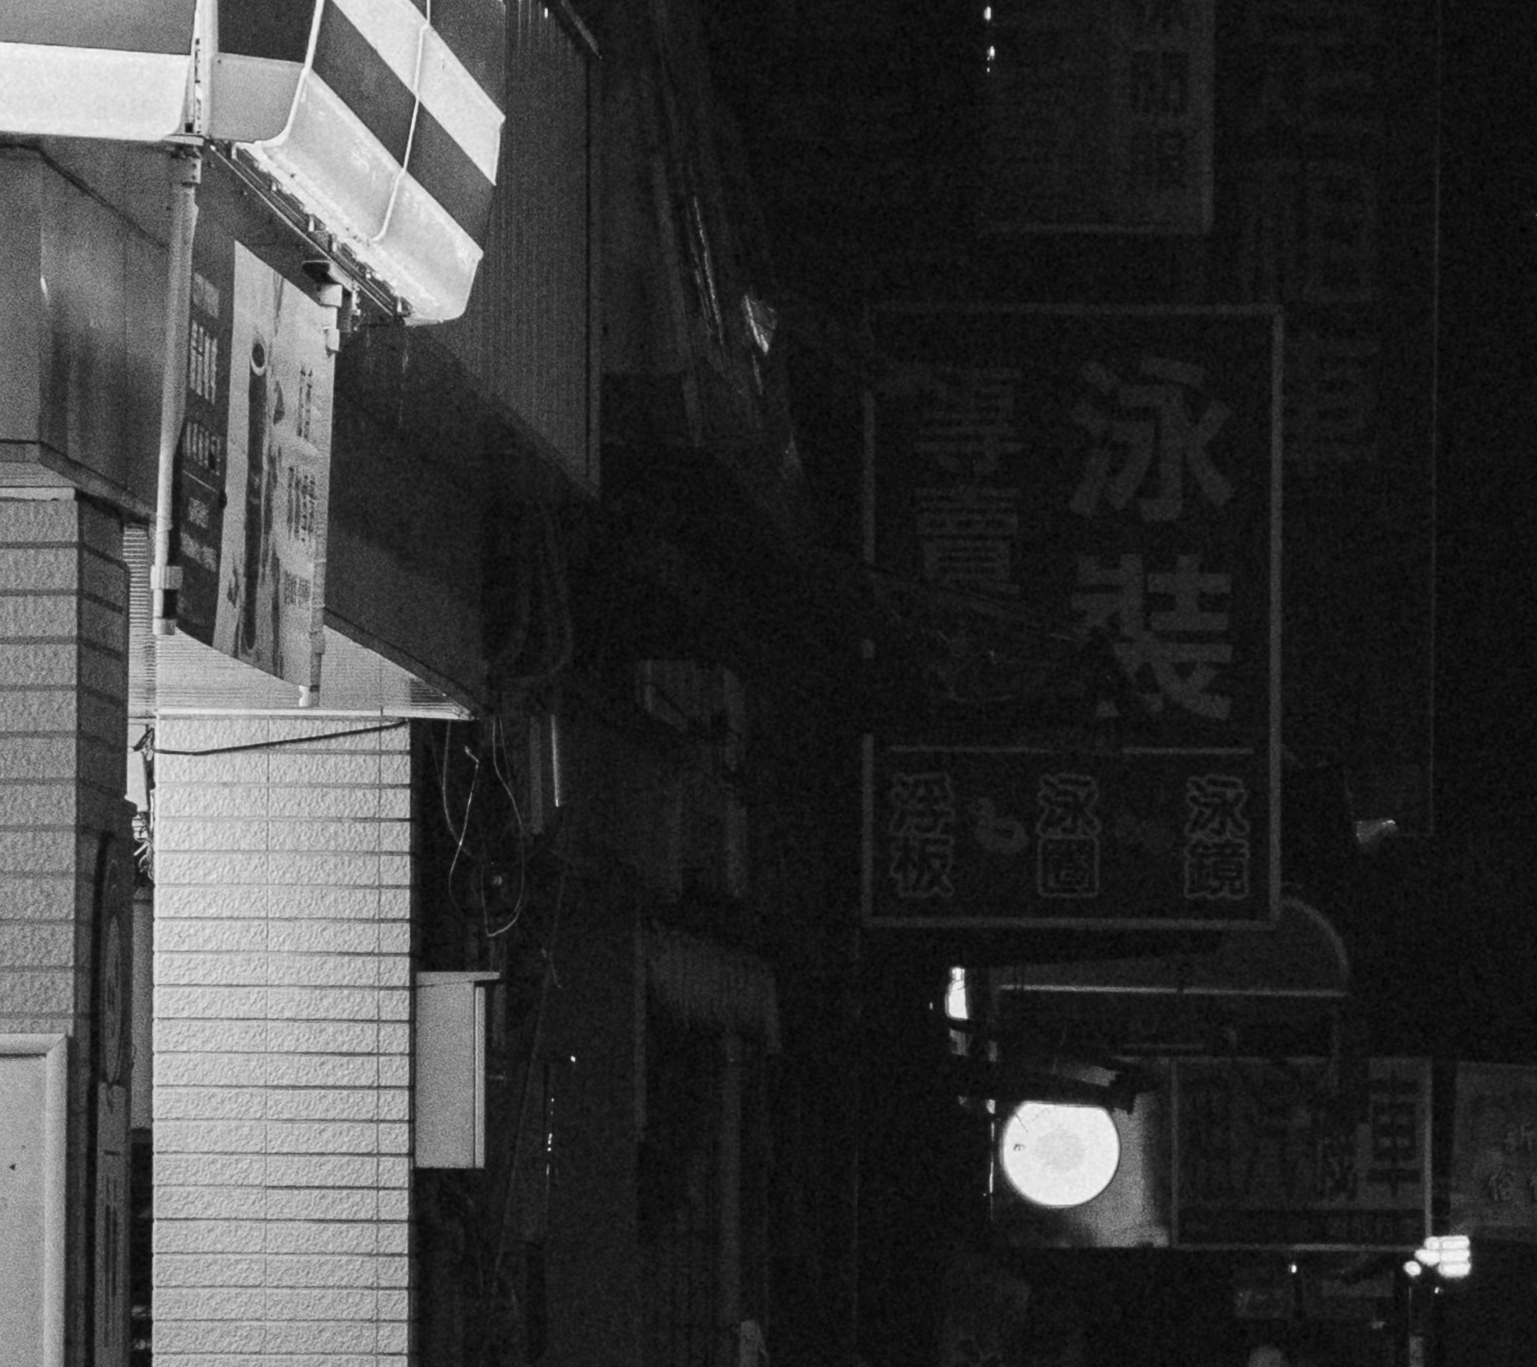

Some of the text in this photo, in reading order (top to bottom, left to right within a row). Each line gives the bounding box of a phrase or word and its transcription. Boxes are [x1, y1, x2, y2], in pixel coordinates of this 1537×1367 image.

[1068, 355, 1236, 721] 泳裝
[889, 774, 955, 899] 浮板
[1184, 774, 1252, 899] 泳鏡
